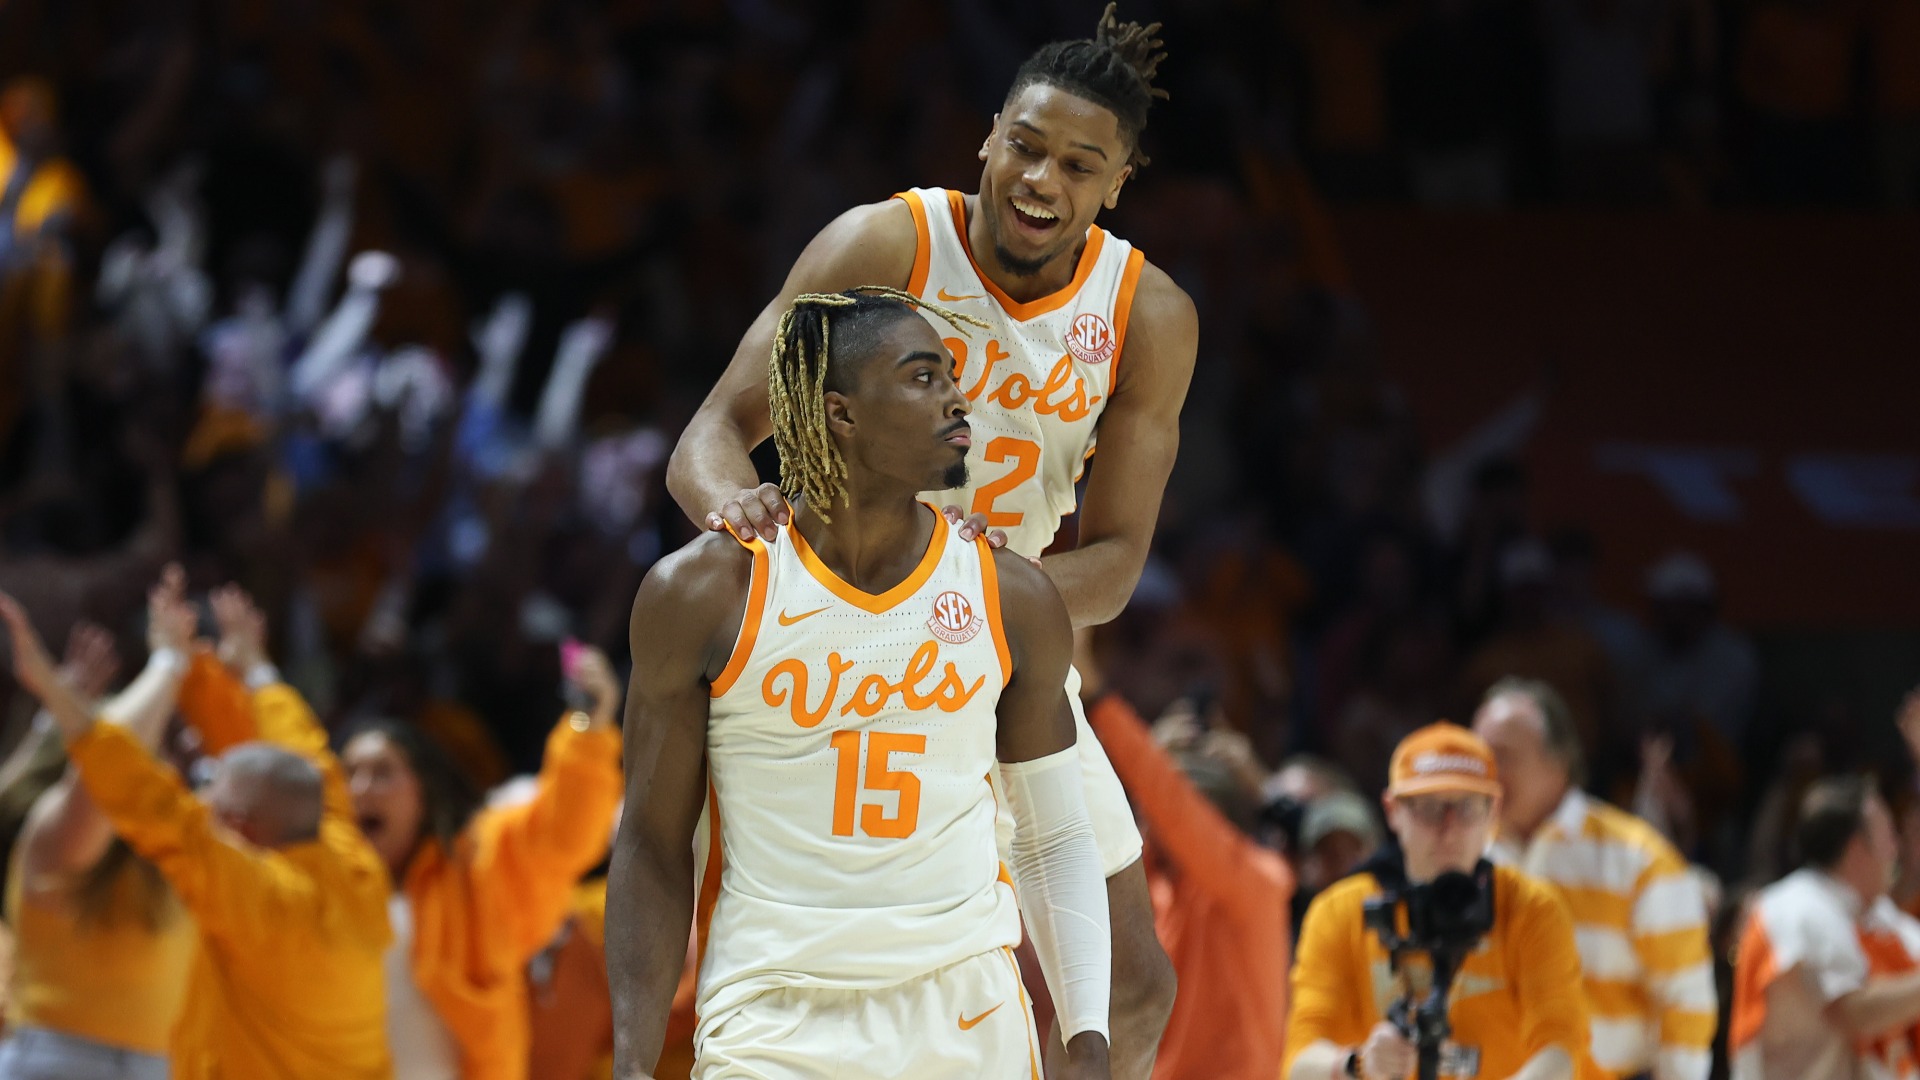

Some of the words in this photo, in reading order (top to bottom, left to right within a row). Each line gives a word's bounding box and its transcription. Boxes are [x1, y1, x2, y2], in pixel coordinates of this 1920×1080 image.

[1070, 342, 1109, 362] GRADUATE
[1073, 314, 1108, 351] SEC
[942, 337, 1101, 422] Vols
[971, 436, 1041, 527] 2
[934, 592, 972, 630] SEC
[934, 626, 977, 642] GRADUATE
[761, 640, 986, 728] Vols
[830, 730, 927, 839] 15
